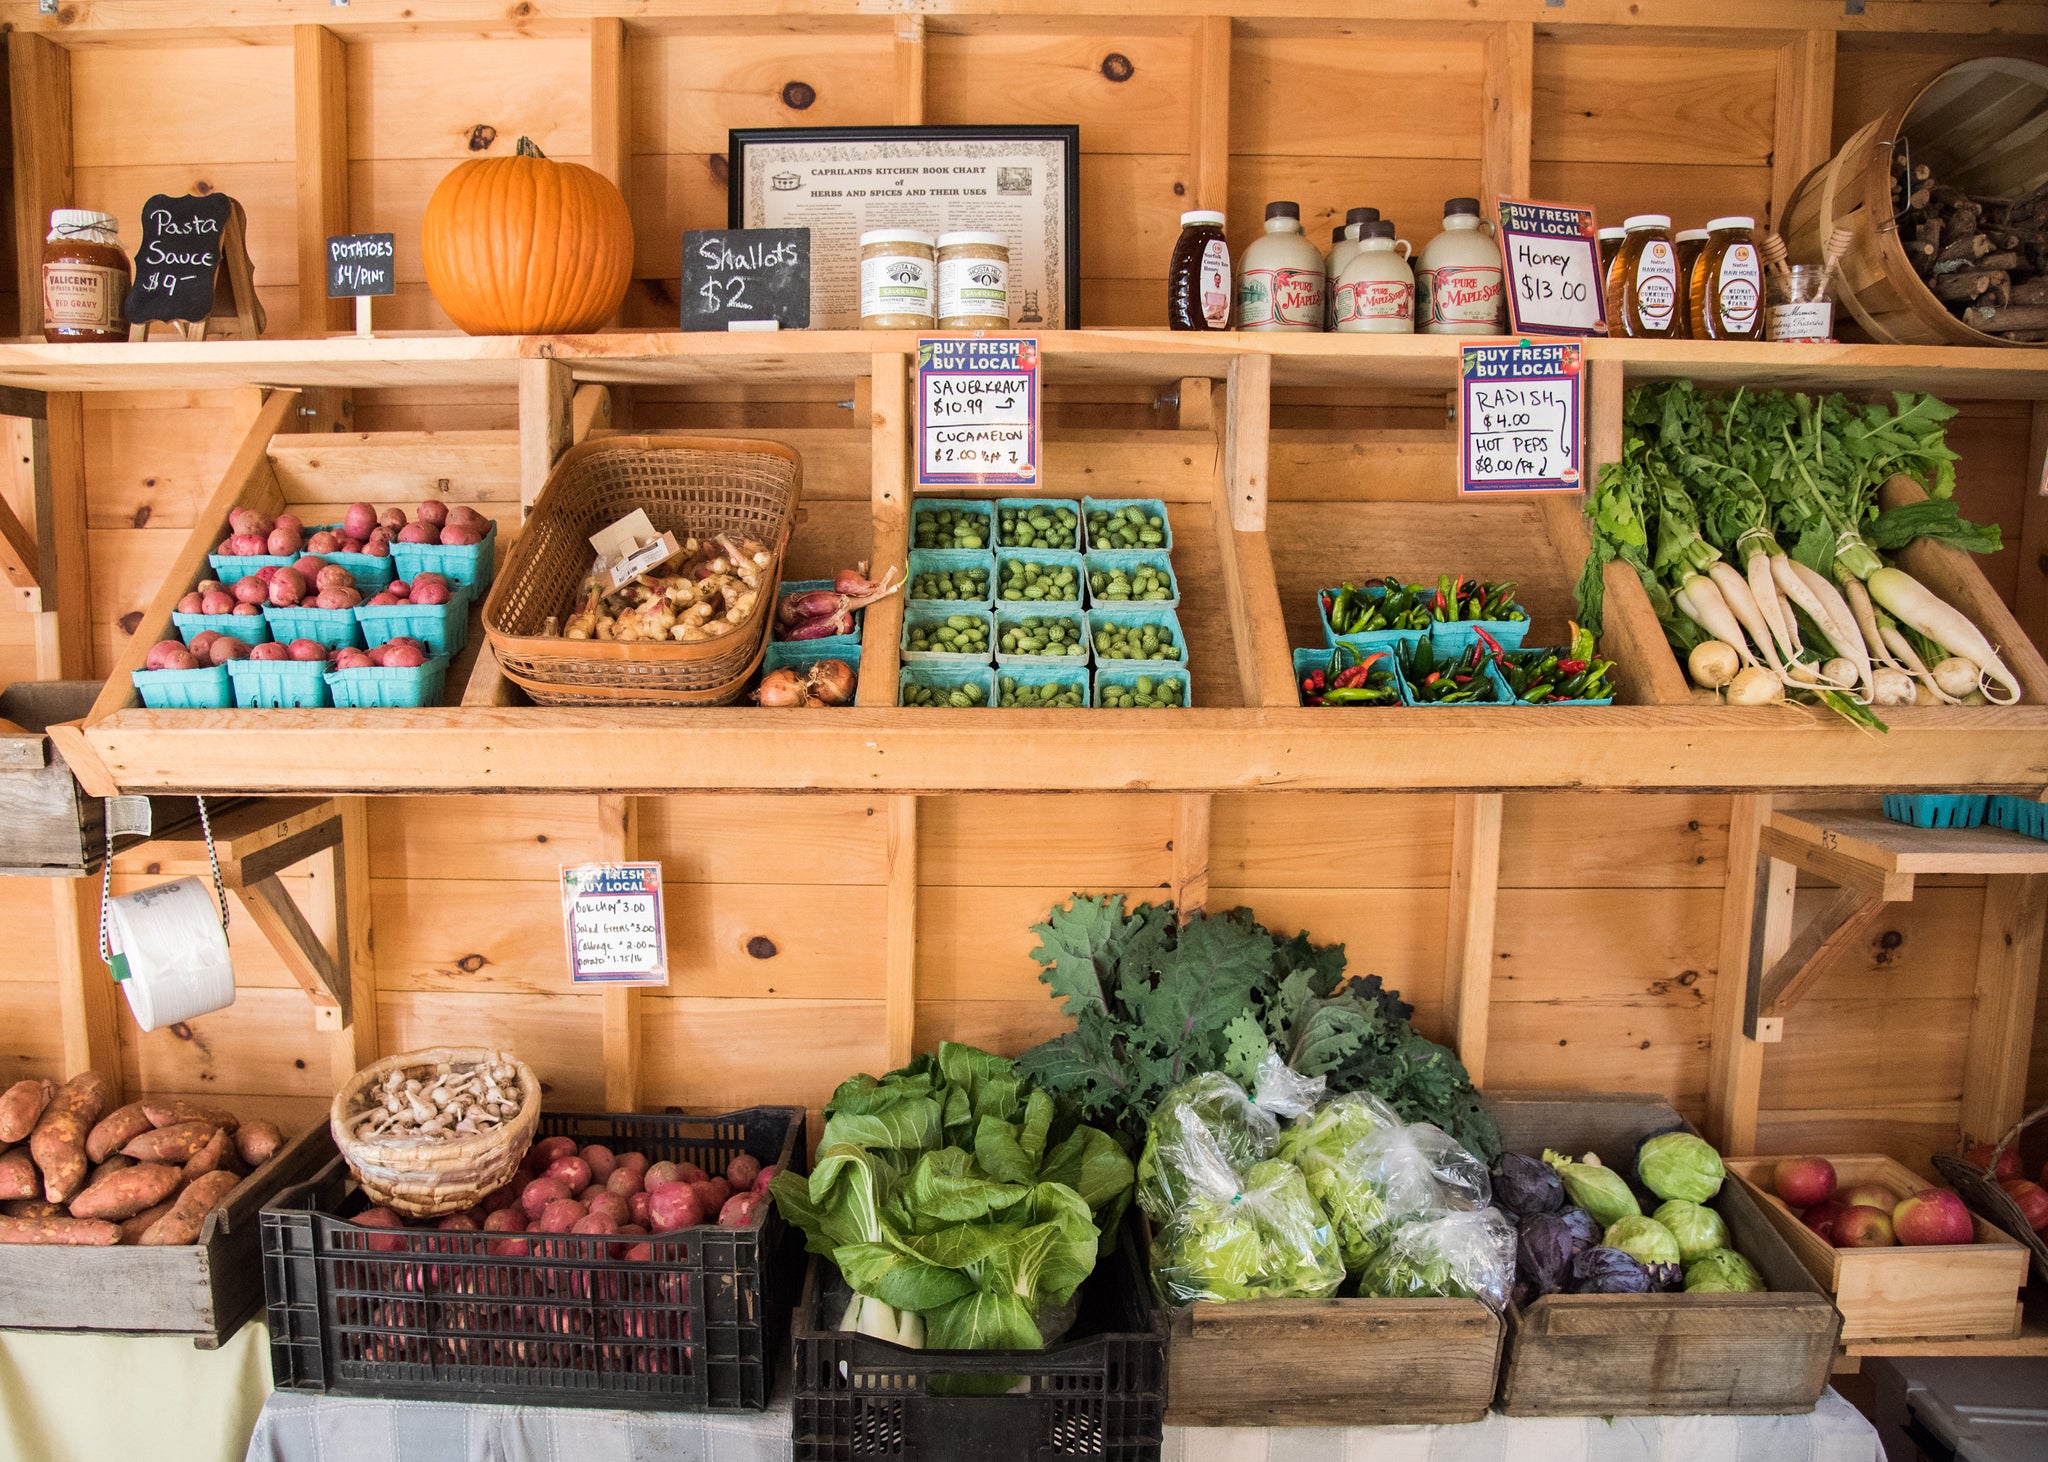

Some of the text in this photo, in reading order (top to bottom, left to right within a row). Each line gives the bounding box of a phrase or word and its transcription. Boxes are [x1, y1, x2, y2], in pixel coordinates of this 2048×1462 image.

[811, 167, 873, 176] CAPRILANDS
[876, 167, 919, 175] KITCHEN
[953, 166, 987, 174] CHART
[811, 190, 843, 198] HERBS
[846, 190, 867, 198] AND
[870, 189, 903, 197] SPICES
[929, 188, 960, 196] THEIR
[963, 188, 987, 196] USES
[1510, 206, 1579, 223] BUY FRESH
[150, 209, 219, 236] Pasta
[1512, 219, 1538, 232] BUY
[145, 240, 214, 267] Sauce
[331, 241, 394, 262] POTATOES
[699, 238, 799, 272] Shallots
[1519, 244, 1571, 277] Honey
[1657, 267, 1674, 275] HONEY
[49, 275, 97, 287] VALICENTI
[1291, 281, 1314, 292] PURE
[1451, 278, 1478, 289] PURE
[699, 275, 753, 314] $2
[1282, 291, 1317, 310] MAPLE
[1362, 295, 1389, 308] MAPLE
[1442, 289, 1483, 309] MAPLE
[55, 299, 97, 309] RED GRAVY
[933, 342, 1020, 355] BUY FRESH
[1477, 347, 1563, 362] BUY FRESH
[933, 357, 968, 370] BUY
[1477, 364, 1512, 377] BUY
[933, 379, 1028, 396] SAUERKRAUT
[933, 397, 983, 416] $10.99
[1475, 388, 1554, 413] RADISH
[936, 430, 1023, 443] CUCAMELON
[1475, 437, 1549, 454] HOT PEPS
